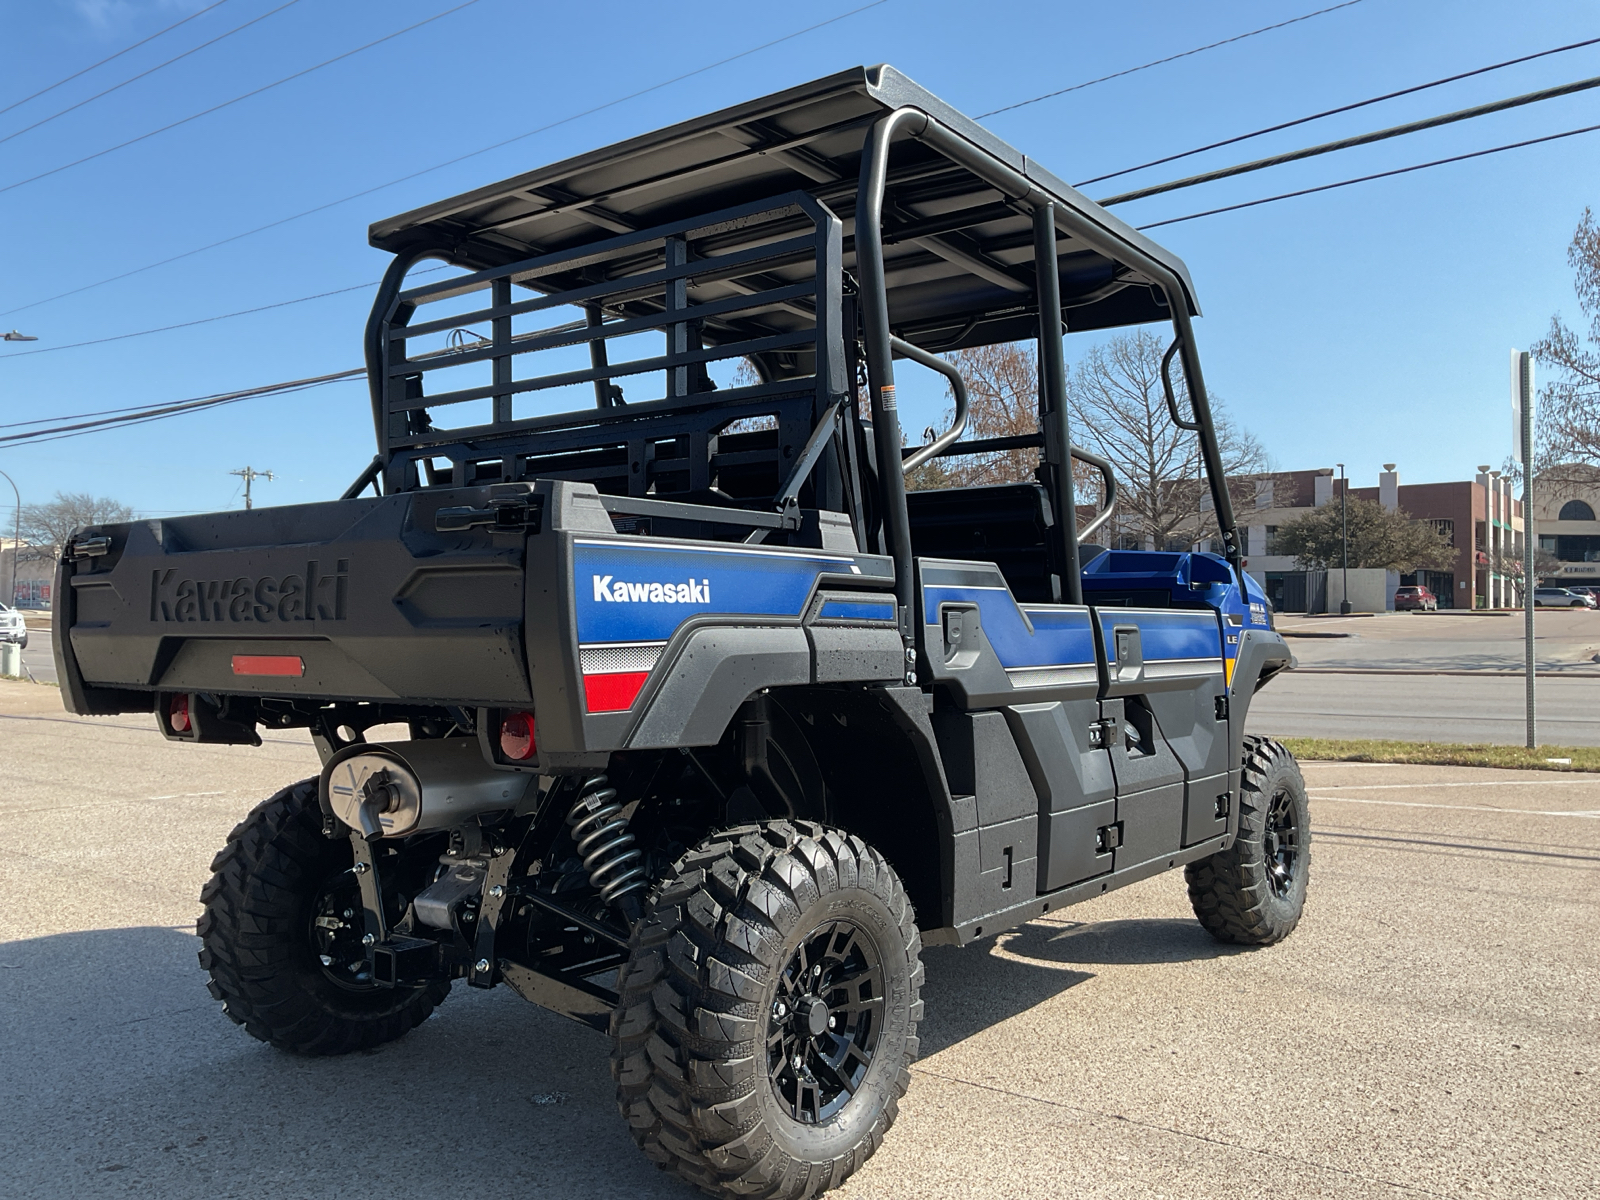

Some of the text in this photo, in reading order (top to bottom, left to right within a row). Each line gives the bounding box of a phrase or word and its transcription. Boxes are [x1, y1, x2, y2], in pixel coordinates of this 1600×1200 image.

[150, 558, 349, 623] Kawasaki
[593, 574, 711, 604] Kawasaki
[1227, 635, 1238, 644] LE
